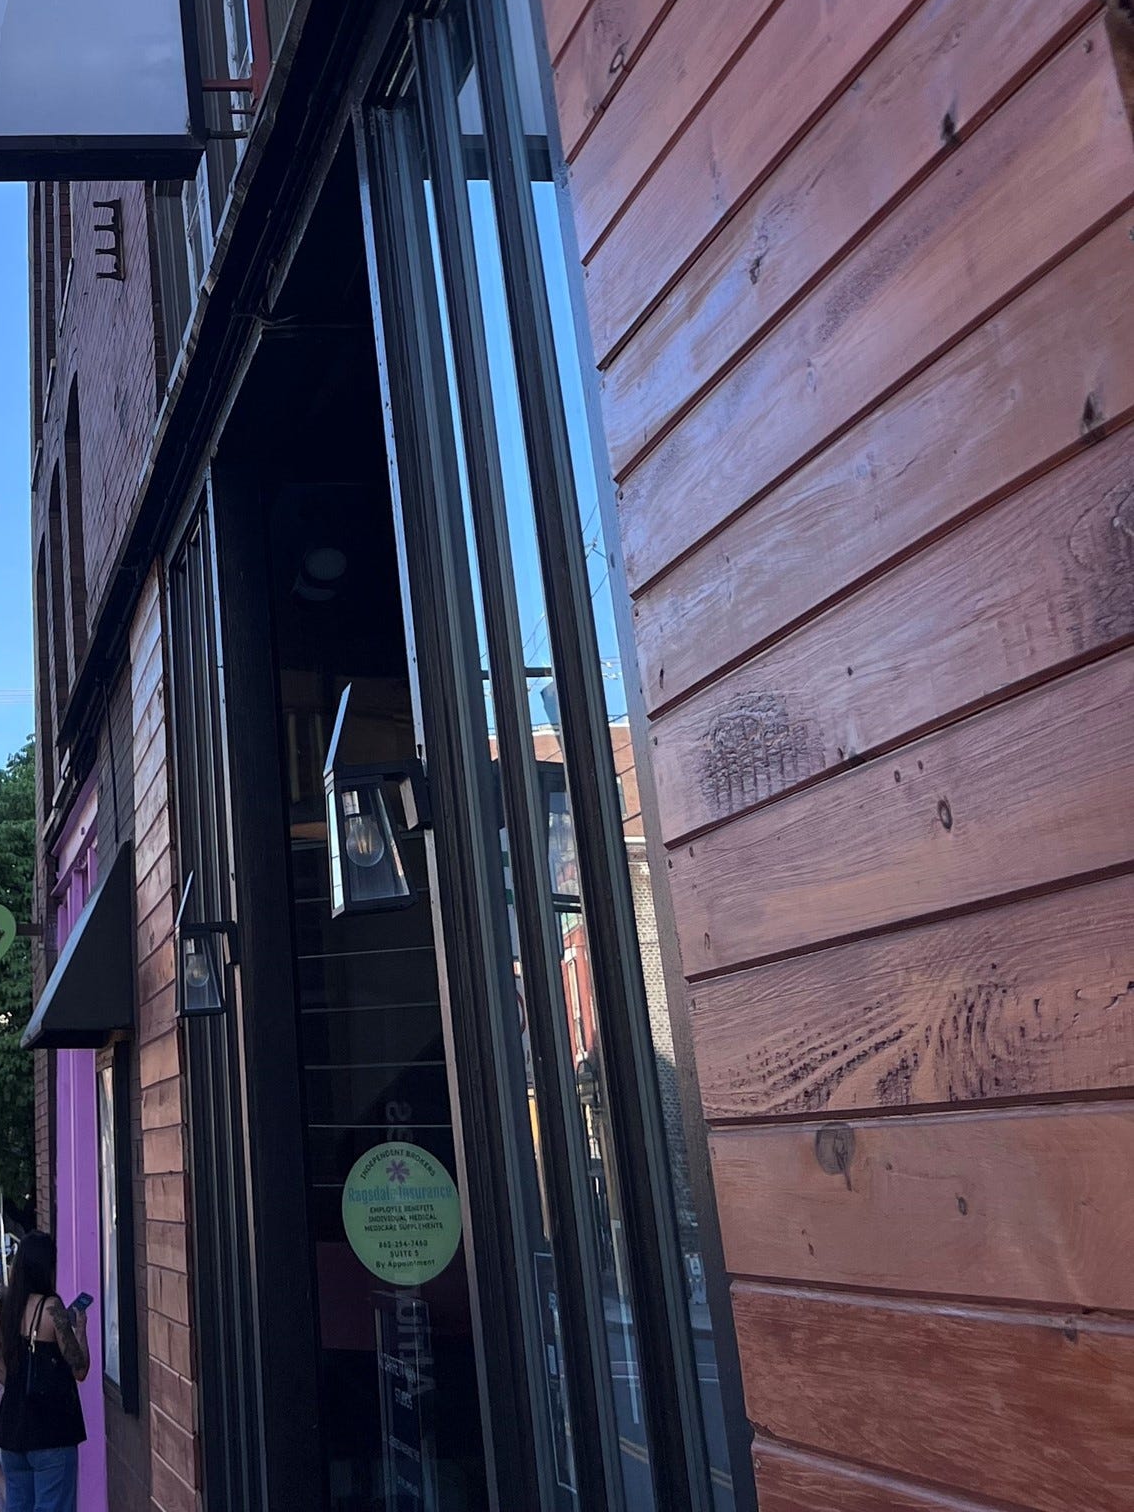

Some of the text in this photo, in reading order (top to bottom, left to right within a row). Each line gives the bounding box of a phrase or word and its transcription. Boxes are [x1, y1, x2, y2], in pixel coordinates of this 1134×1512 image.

[360, 1149, 436, 1180] INDEPENDENT BROKERS
[399, 1186, 452, 1199] Insurance
[369, 1204, 434, 1214] EMPLOYEE BENEFITS
[368, 1214, 437, 1224] INDIVIDUAL MEDICAL
[364, 1222, 443, 1232] MEDICARE SUPPLEMENTS
[389, 1250, 413, 1258] SUITE
[376, 1259, 436, 1270] By Appointment
